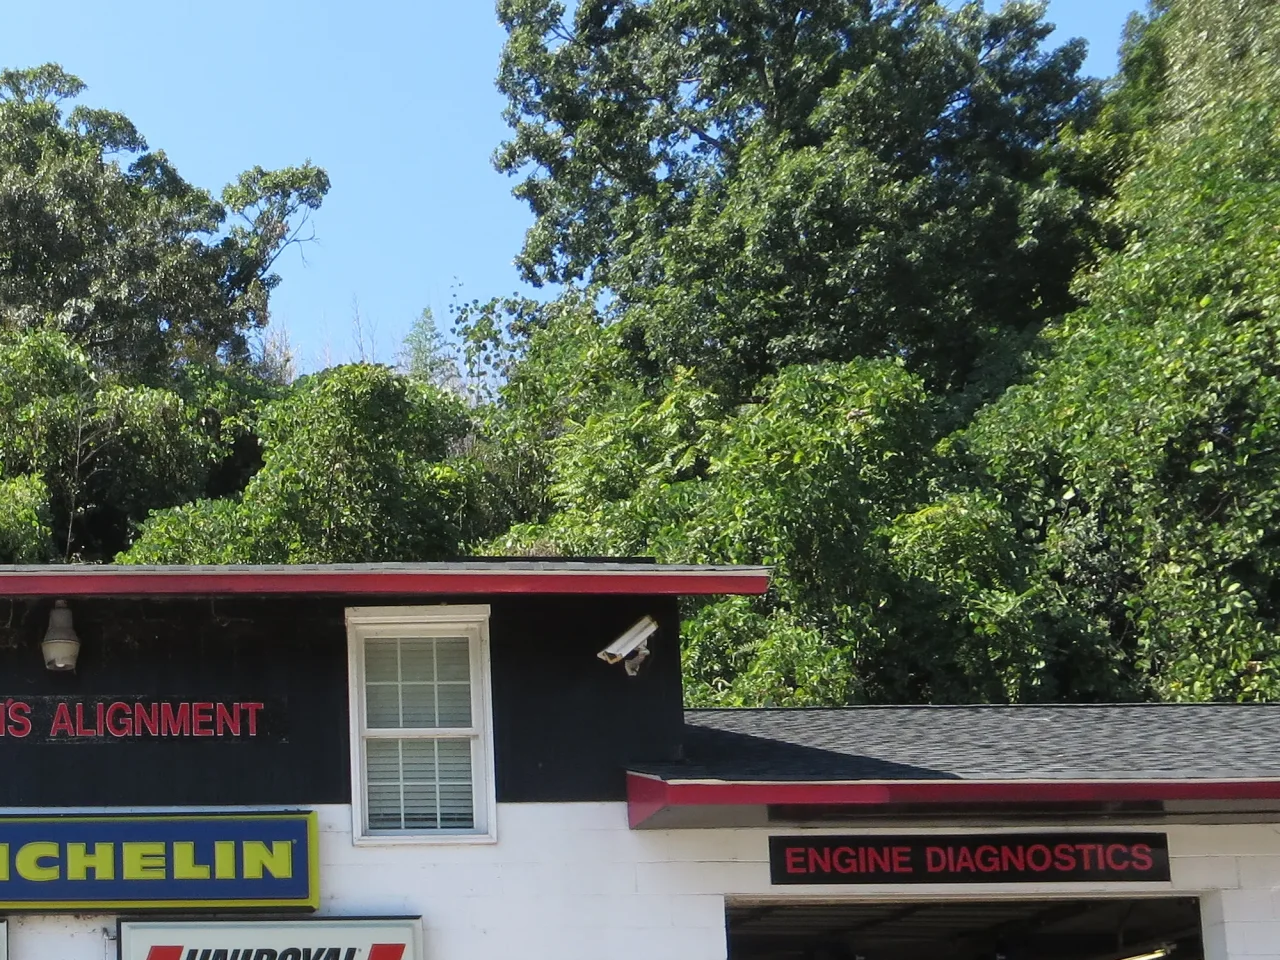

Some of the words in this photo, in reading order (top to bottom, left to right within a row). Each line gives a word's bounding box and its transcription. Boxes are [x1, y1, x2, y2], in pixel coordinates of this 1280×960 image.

[50, 701, 264, 737] ALIGNMENT
[785, 846, 913, 874] ENGINE
[925, 843, 1154, 873] DIAGNOSTICS
